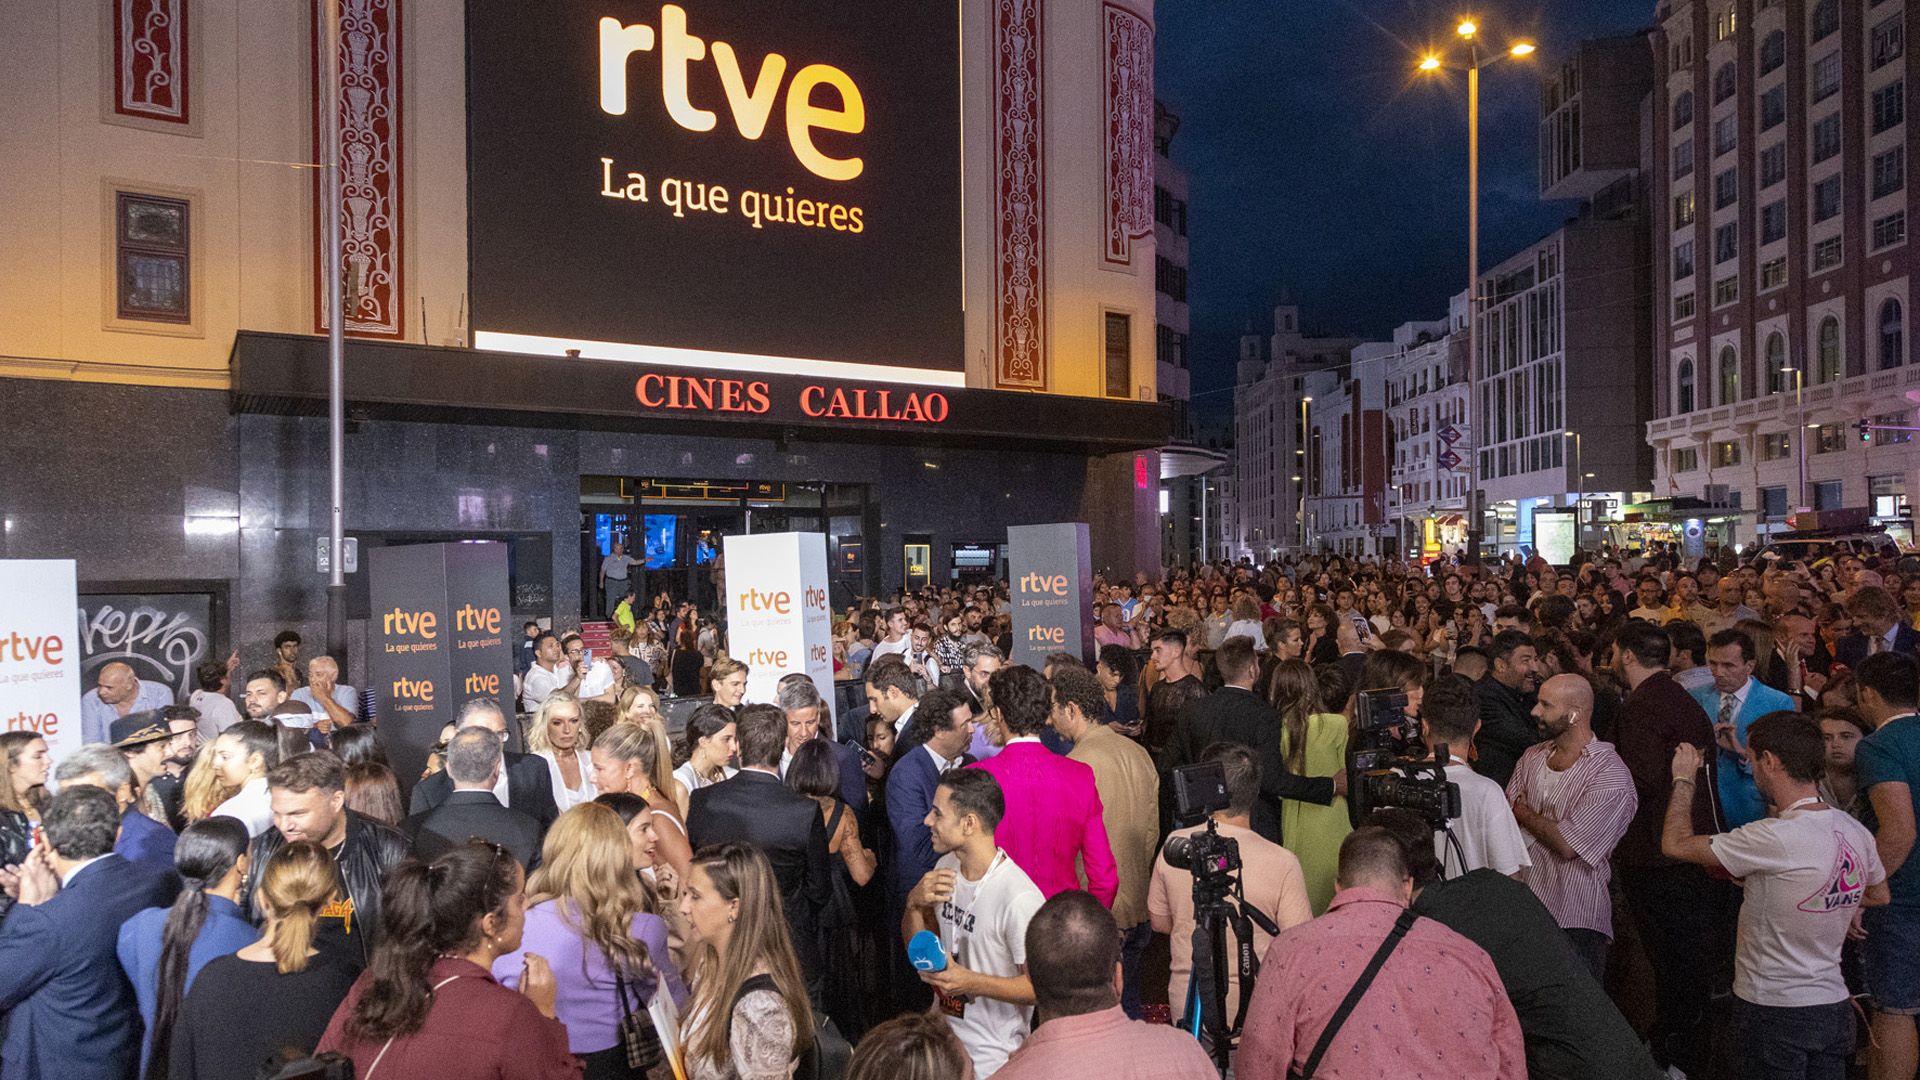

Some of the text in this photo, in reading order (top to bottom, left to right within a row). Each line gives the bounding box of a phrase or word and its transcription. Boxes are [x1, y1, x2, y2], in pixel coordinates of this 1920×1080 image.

[599, 4, 865, 181] rtve
[601, 157, 865, 234] La que quieres
[635, 373, 949, 423] CINES CALLAO
[1577, 500, 1616, 508] HUEI
[1020, 572, 1068, 596] rtve
[740, 588, 791, 614] rtve
[805, 585, 826, 611] rtve
[1022, 598, 1030, 607] La
[1044, 598, 1068, 607] quieres
[384, 607, 437, 639] rtve
[456, 604, 501, 635] rtve
[458, 638, 501, 650] La que quieres
[1028, 624, 1065, 643] rtve
[0, 631, 63, 665] rtve
[385, 642, 437, 654] La que quieres
[749, 648, 787, 668] rtve
[811, 643, 827, 663] rtve
[393, 677, 434, 701] rtve
[465, 672, 499, 694] rtve
[7, 711, 59, 736] rtve
[1825, 891, 1860, 909] VANS
[1242, 942, 1250, 976] Canon
